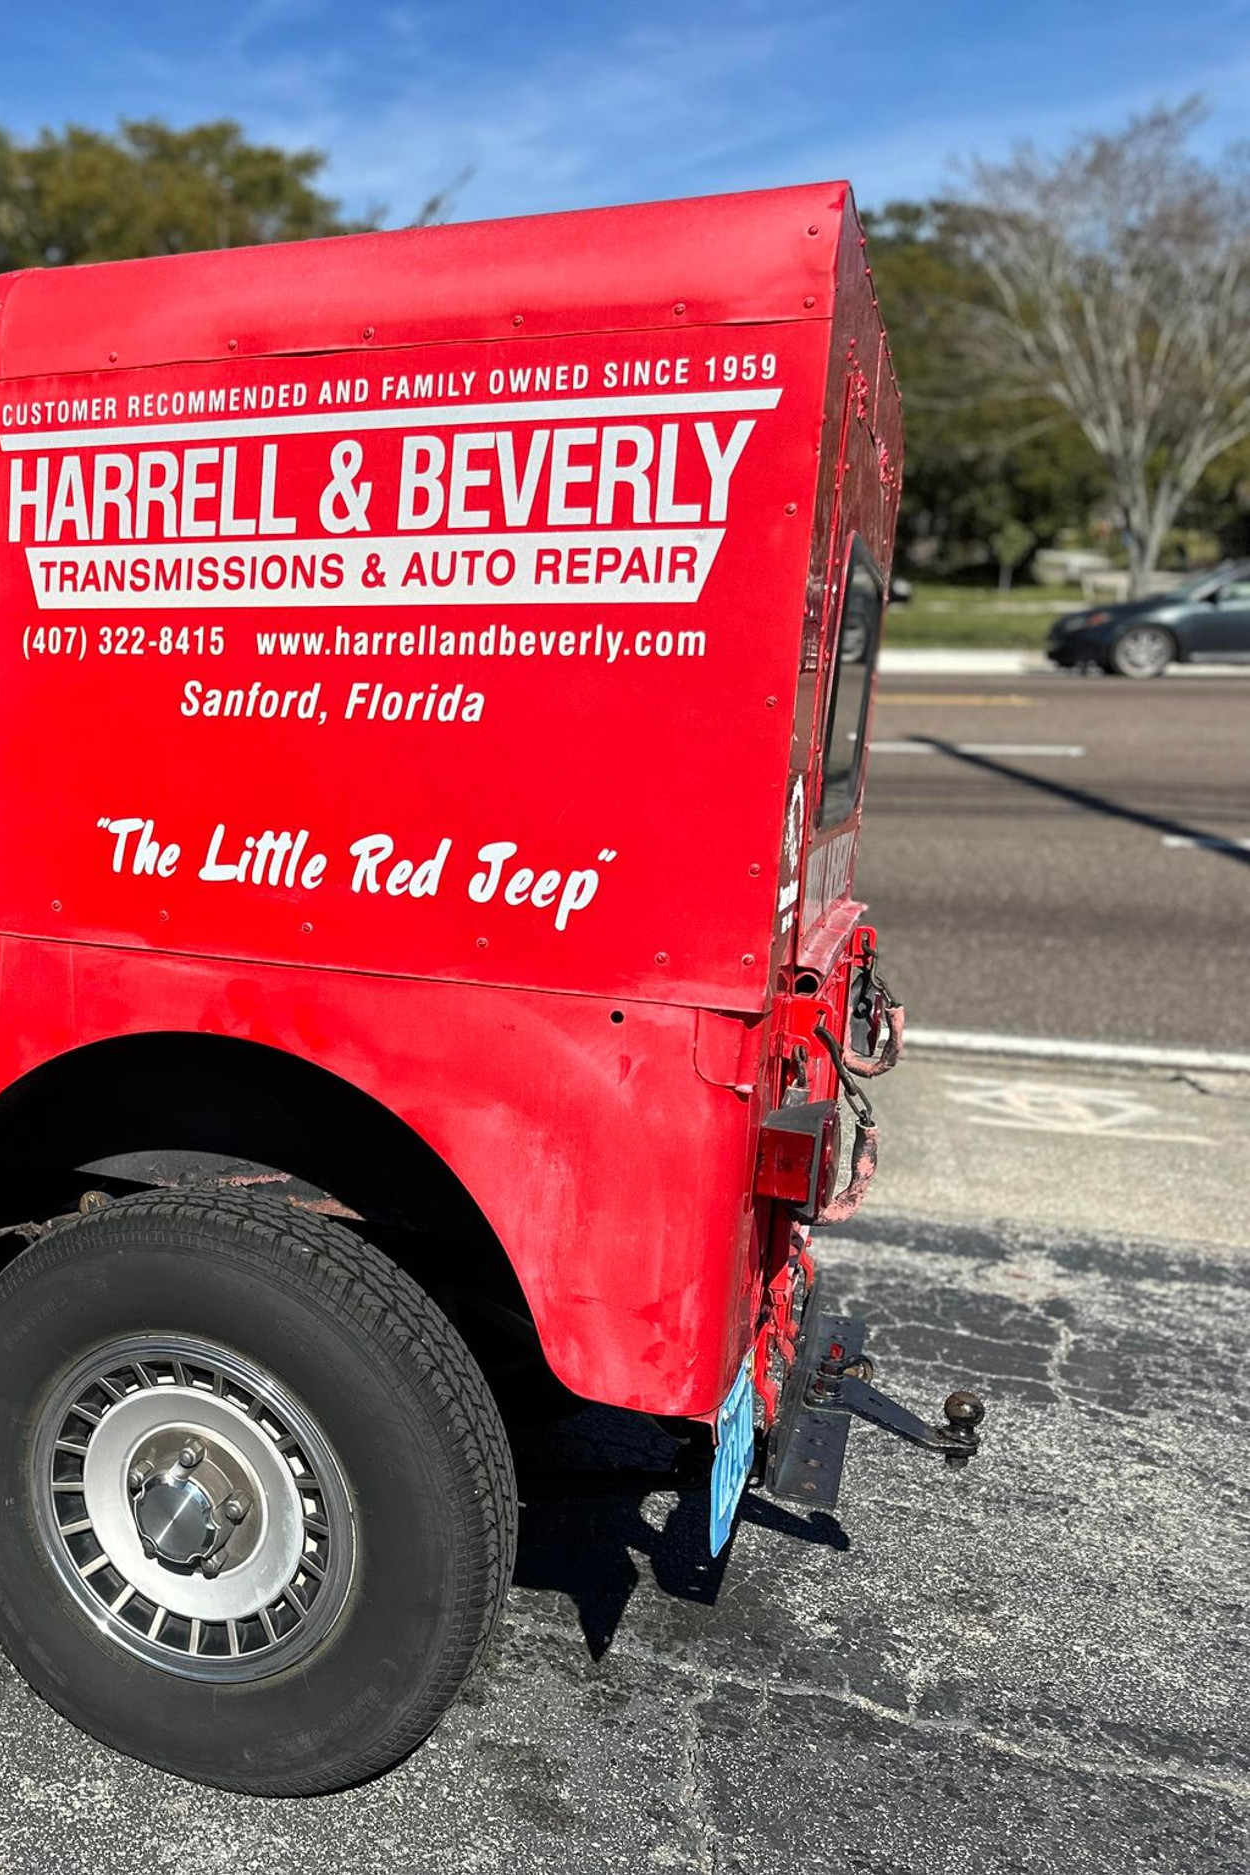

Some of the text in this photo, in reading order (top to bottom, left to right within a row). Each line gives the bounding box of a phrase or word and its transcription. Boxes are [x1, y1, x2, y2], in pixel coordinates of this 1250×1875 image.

[3, 354, 776, 426] CUSTOMER RECOMMENDED AND FAMILY OWNED SINCE 1959
[9, 420, 756, 542] HARRELL & BEVERLY
[40, 546, 697, 592] TRANSMISSIONS & AUTO REPAIR
[23, 624, 705, 663] (407) 322-8415 www.harrellandbeverly.com
[181, 681, 484, 724] Sanford, Florida
[199, 824, 327, 889] Little
[350, 834, 452, 897] Red
